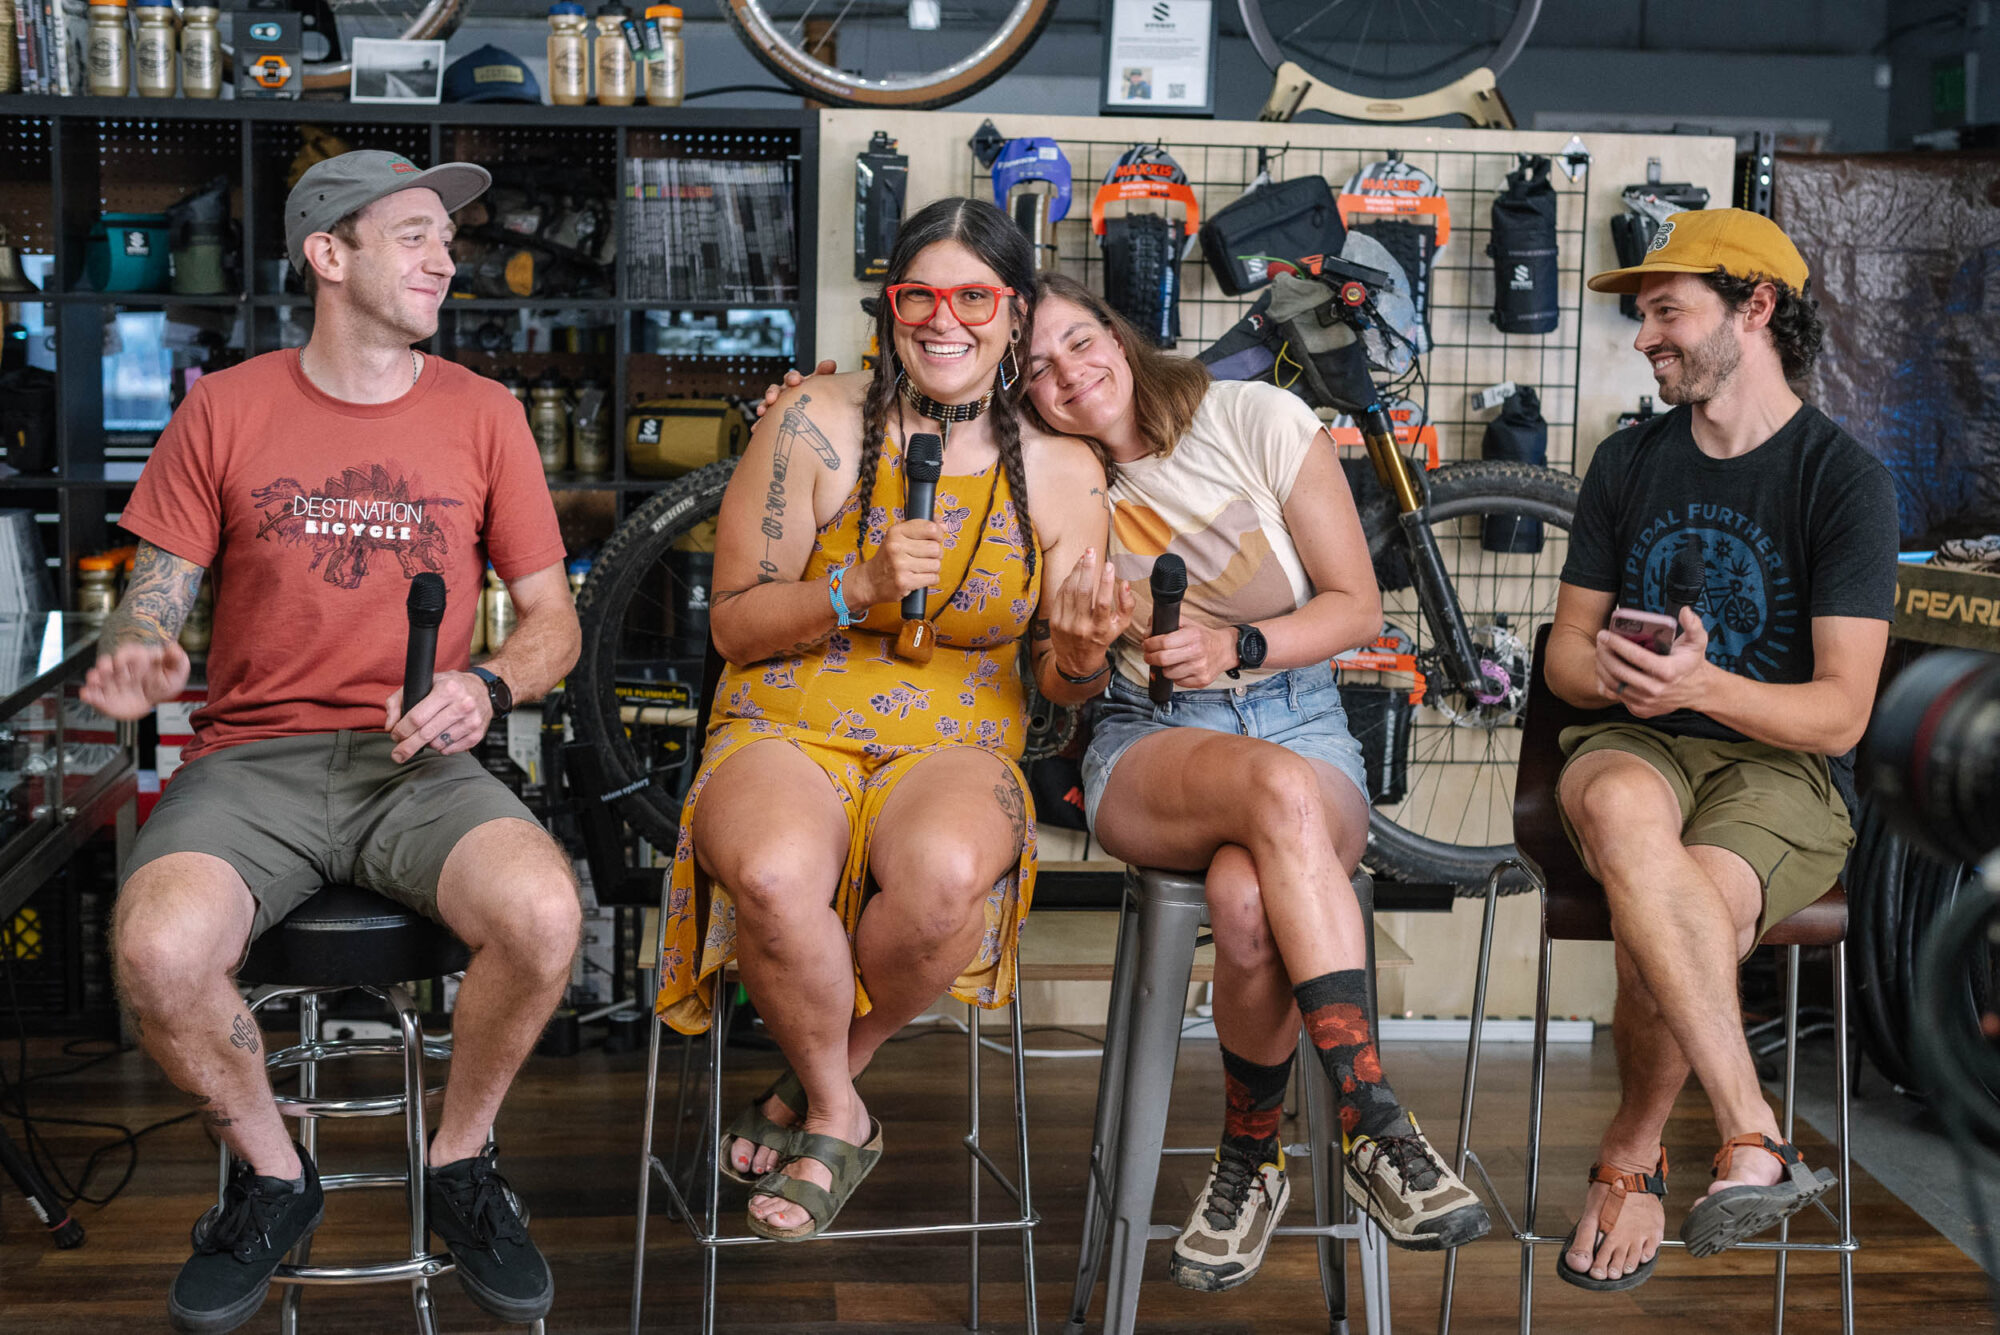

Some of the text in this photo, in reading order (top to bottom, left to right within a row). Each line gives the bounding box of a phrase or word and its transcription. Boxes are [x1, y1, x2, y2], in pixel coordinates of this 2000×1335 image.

[1115, 163, 1174, 178] MAXXIS
[1361, 178, 1423, 191] MAXXIS
[293, 495, 423, 525] DESTINATION
[305, 520, 411, 540] BICYCLE
[1625, 503, 1783, 576] PEDAL FURTHER
